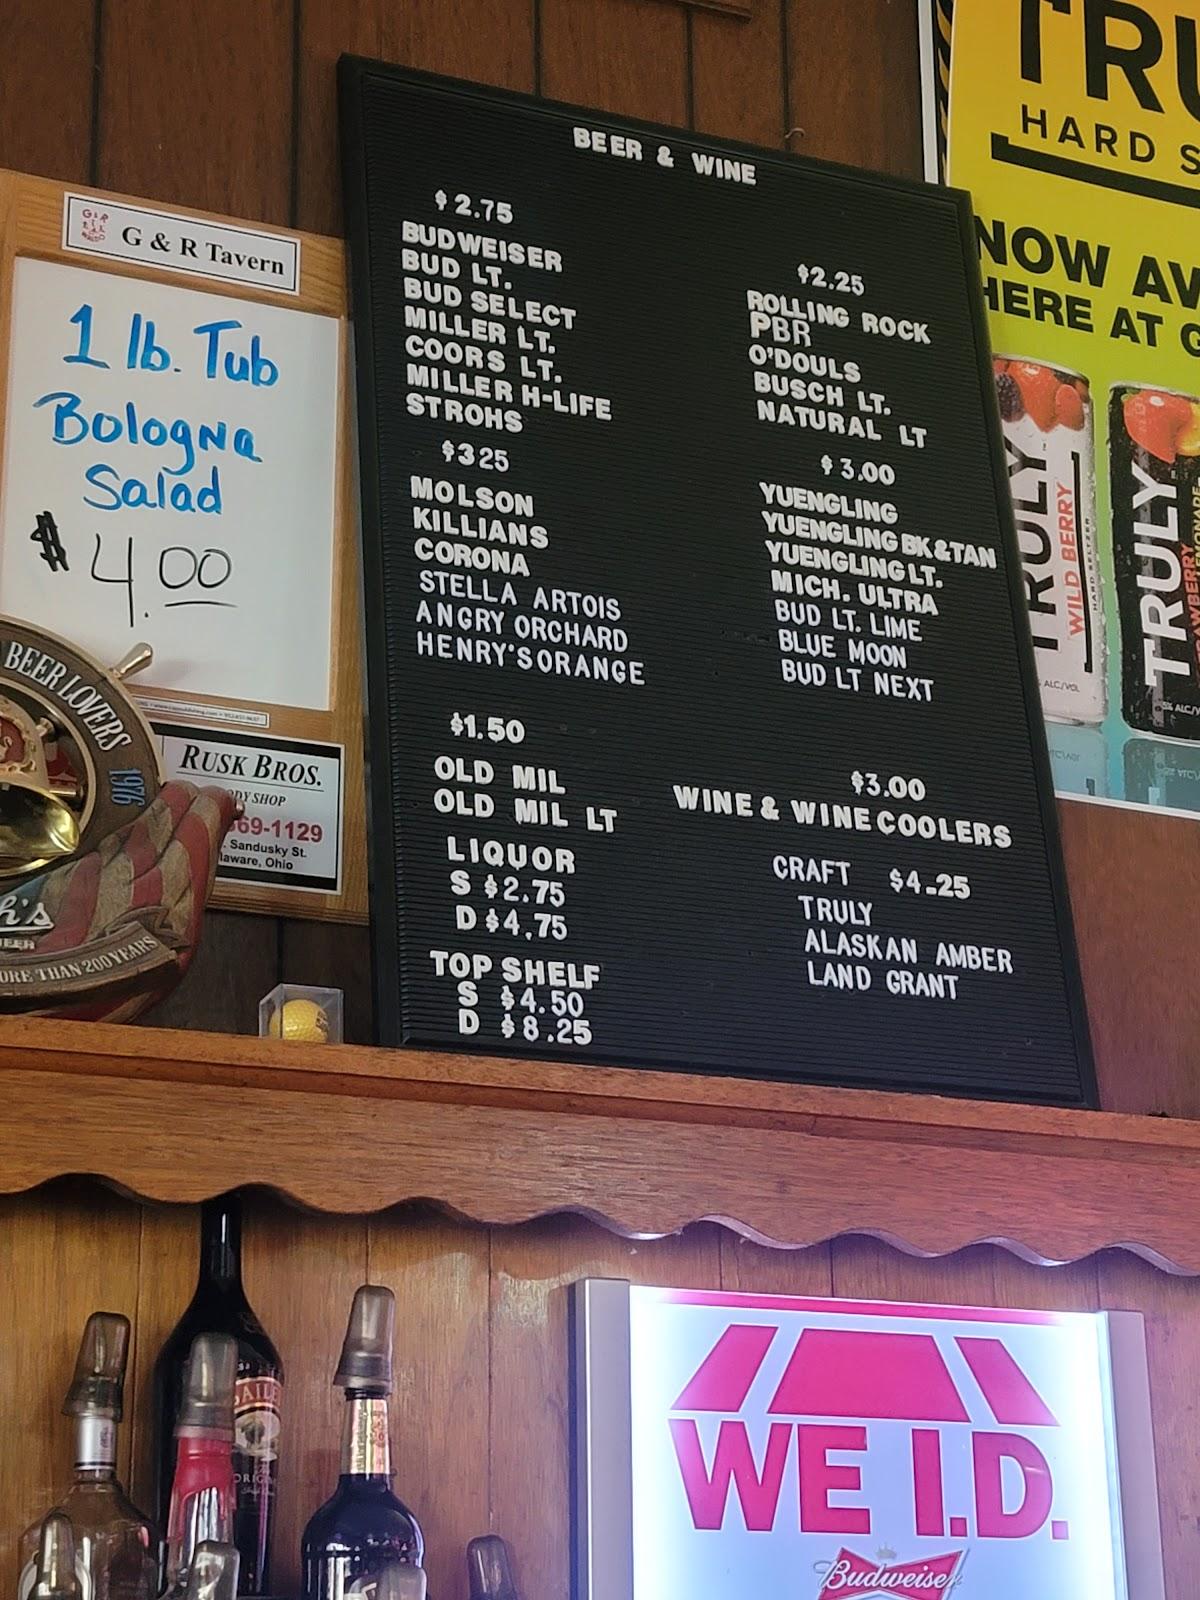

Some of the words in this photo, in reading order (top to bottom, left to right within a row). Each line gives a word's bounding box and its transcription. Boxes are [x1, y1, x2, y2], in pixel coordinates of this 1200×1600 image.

[1021, 104, 1156, 163] HARD
[573, 126, 643, 161] BEER
[656, 146, 674, 168] &
[691, 153, 757, 186] WINE
[434, 189, 514, 224] $2.75
[122, 226, 142, 247] G
[150, 232, 171, 253] &
[179, 237, 200, 259] R
[205, 242, 285, 275] Tavern
[402, 220, 563, 272] BUDWEISER
[974, 215, 1111, 288] NOW
[1132, 255, 1200, 310] AV
[401, 248, 461, 279] BUD
[471, 262, 512, 290] LT.
[797, 263, 865, 296] $2.25
[403, 276, 463, 307] BUD
[470, 290, 577, 329] SELECT
[747, 290, 850, 328] ROLLING
[861, 312, 931, 344] ROCK
[982, 276, 1095, 333] HERE
[1110, 307, 1163, 348] AT
[63, 303, 111, 369] 1
[126, 313, 182, 373] lb.
[194, 320, 279, 387] Tub
[404, 305, 507, 345] MILLER
[517, 325, 556, 354] LT.
[750, 311, 811, 347] PBR
[405, 335, 506, 373] COORS
[520, 356, 563, 383] LT.
[749, 344, 861, 382] O'DOULS
[406, 393, 523, 433] STROHS
[407, 363, 513, 403] MILLER
[521, 384, 612, 420] H-LIFE
[754, 371, 844, 407] BUSCH
[857, 391, 892, 416] LT.
[757, 400, 882, 441] NATURAL
[899, 425, 927, 448] LT
[442, 440, 510, 472] $325
[83, 463, 223, 515] Salad
[410, 475, 534, 518] MOLSON
[759, 482, 899, 525] YUENGLING
[413, 506, 549, 549] KILLIANS
[761, 511, 899, 553] YUENGLING
[1056, 482, 1077, 563] BERRY
[414, 537, 530, 577] CORONA
[765, 540, 906, 582] YUENGLING
[908, 563, 943, 588] LT.
[1131, 460, 1191, 687] TRULY
[419, 569, 518, 606] STELLA
[533, 586, 622, 621] ARTOIS
[770, 570, 850, 602] MICH.
[857, 583, 939, 616] ULTRA
[1067, 570, 1087, 641] WILD
[415, 600, 504, 634] ANGRY
[514, 614, 628, 652] ORCHARD
[774, 599, 821, 627] BUD
[831, 607, 862, 633] LT.
[869, 612, 923, 642] LIME
[778, 629, 837, 658] BLUE
[848, 638, 907, 669] MOON
[3, 641, 68, 691] BEER
[56, 674, 133, 751] LOVERS
[781, 658, 827, 686] BUD
[835, 666, 862, 692] LT
[873, 671, 934, 702] NEXT
[450, 712, 525, 743] $1.50
[109, 768, 146, 806] 1976
[179, 744, 249, 777] RUSK
[252, 753, 322, 787] BROS.
[434, 755, 495, 785] OLD
[512, 764, 566, 795] MIL
[850, 770, 926, 802] $3.00
[251, 792, 287, 807] SHOP
[433, 788, 495, 818] OLD
[514, 798, 569, 827] MIL
[586, 806, 618, 833] LT
[672, 784, 753, 817] WINE
[760, 796, 780, 822] &
[791, 800, 872, 832] WINE
[877, 810, 1012, 848] COOLERS
[219, 851, 262, 868] laware,
[265, 857, 294, 870] Ohio
[230, 839, 289, 858] Sandusky
[291, 846, 307, 858] St.
[447, 836, 576, 874] LIQUOR
[450, 870, 471, 896] S
[484, 873, 565, 907] $2.75
[772, 855, 851, 886] CRAFT
[455, 905, 477, 930] D
[798, 895, 873, 926] TRULY
[0, 938, 36, 950] EER
[35, 962, 82, 982] THAN
[82, 955, 113, 974] 200
[109, 935, 158, 964] YEARS
[804, 928, 918, 964] ALASKAN
[935, 942, 1014, 974] AMBER
[430, 950, 493, 979] TOP
[501, 956, 600, 989] SHELF
[807, 960, 872, 991] LAND
[886, 970, 959, 1000] GRANT
[457, 981, 479, 1007] S
[458, 1008, 480, 1034] D
[234, 1382, 281, 1406] AILE
[668, 1419, 871, 1535] WE
[911, 1427, 1070, 1540] I.D.
[813, 1559, 963, 1590] Budweiser
